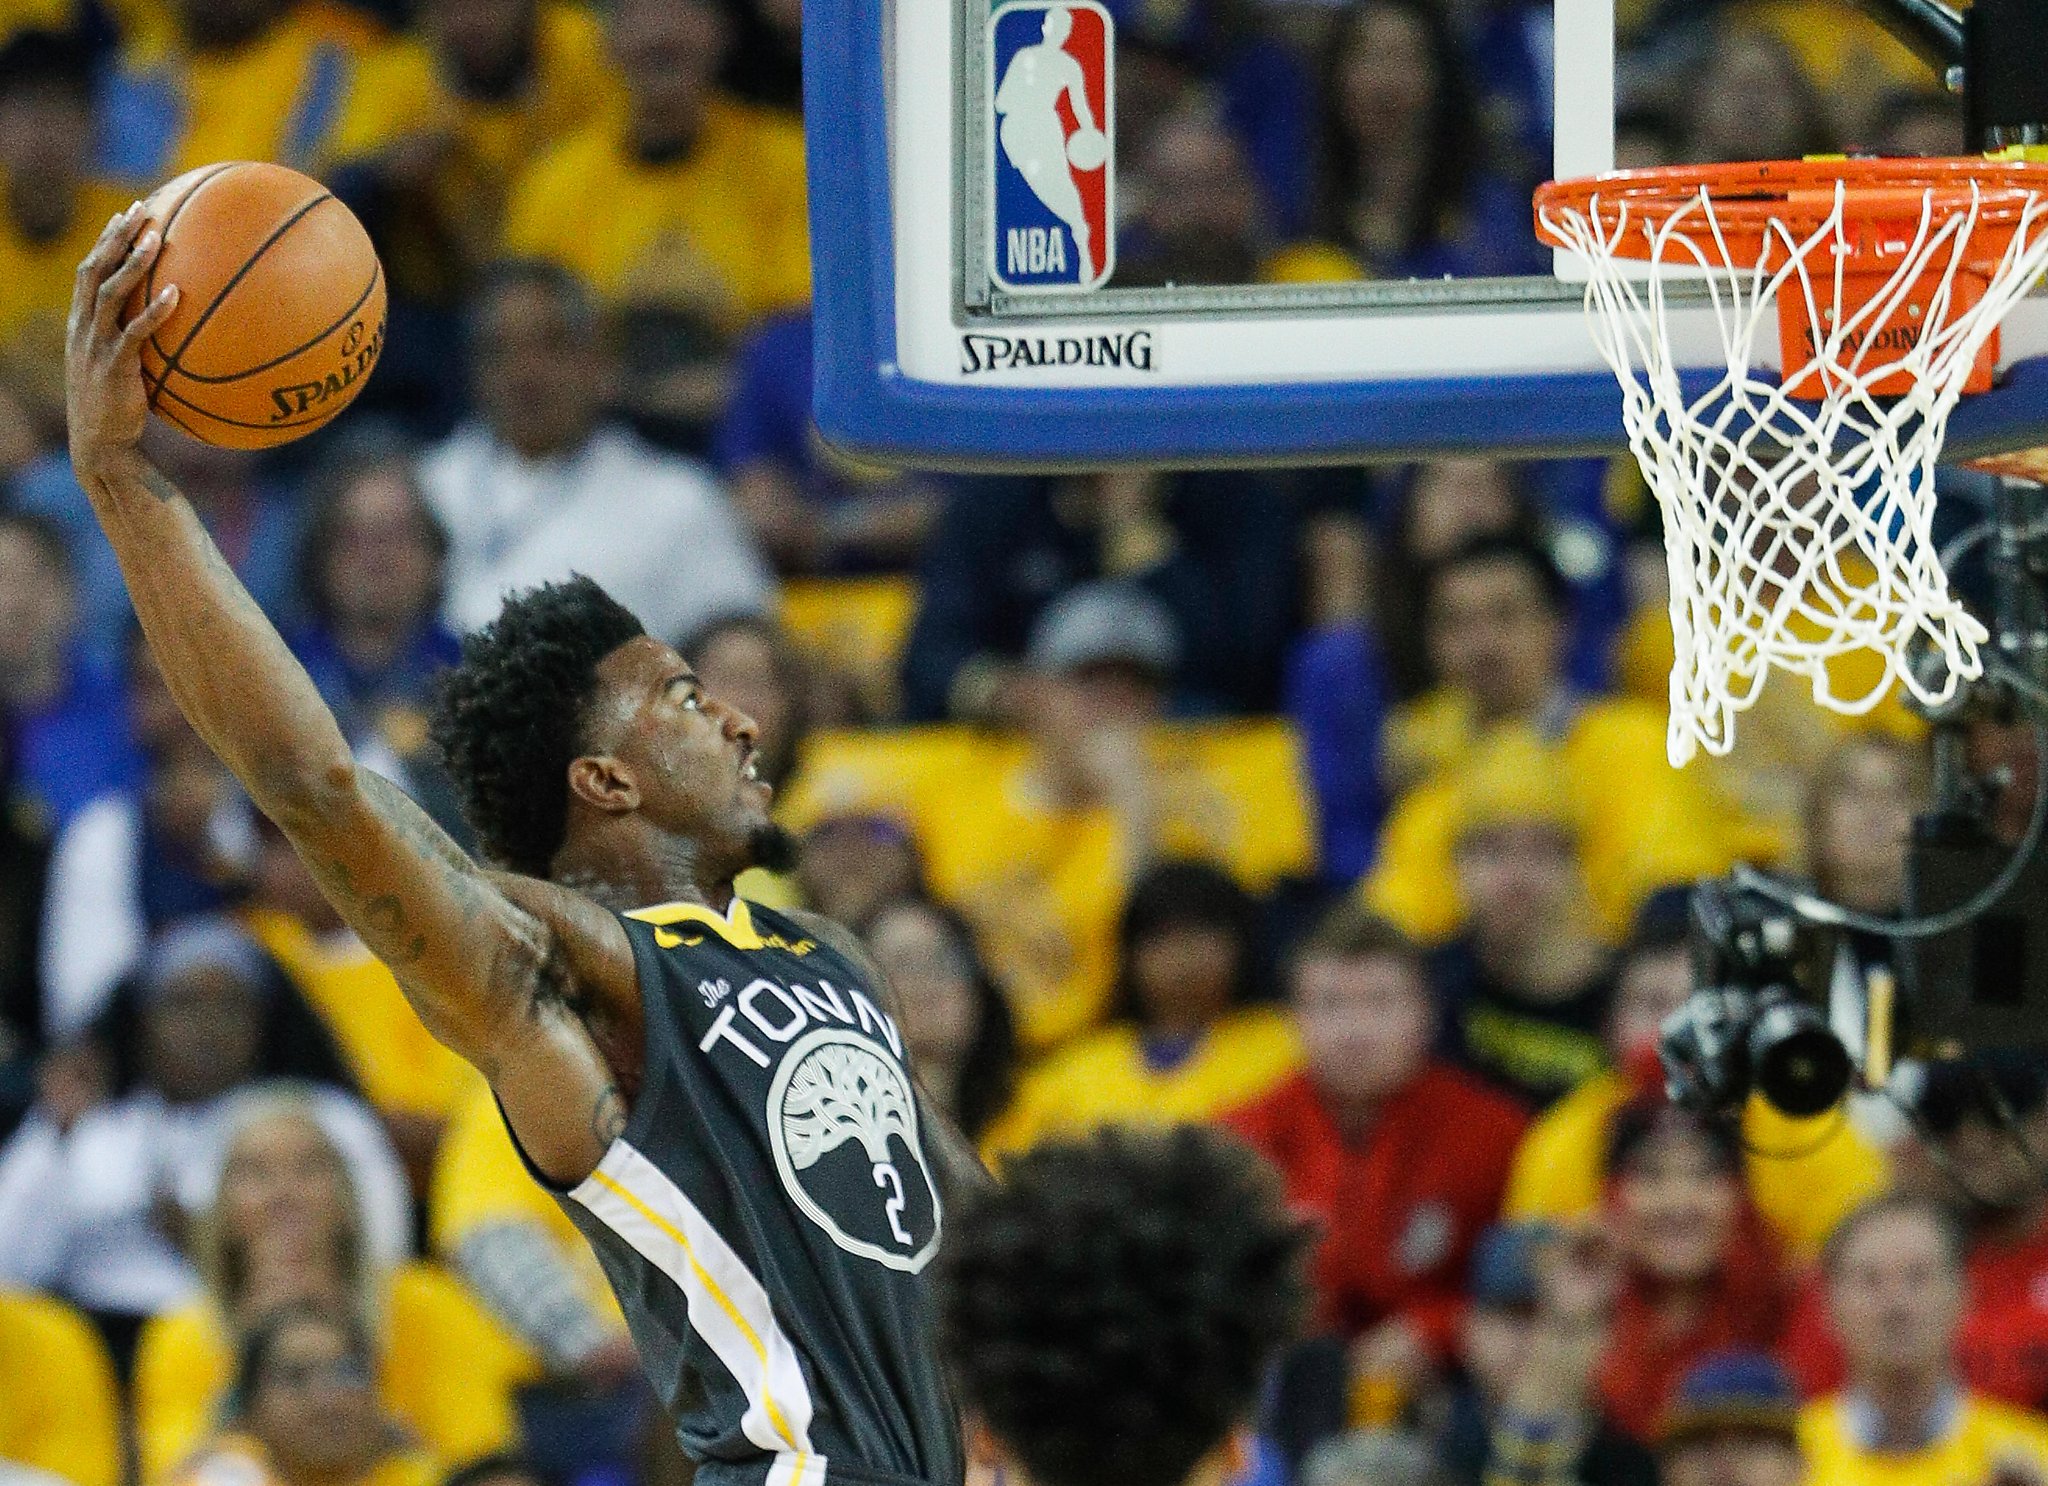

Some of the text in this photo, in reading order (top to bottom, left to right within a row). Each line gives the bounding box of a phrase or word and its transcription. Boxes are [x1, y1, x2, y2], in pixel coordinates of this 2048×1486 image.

[1006, 227, 1067, 275] NBA
[962, 330, 1151, 374] SPALDING
[697, 977, 731, 1009] The
[872, 1162, 913, 1245] 2
